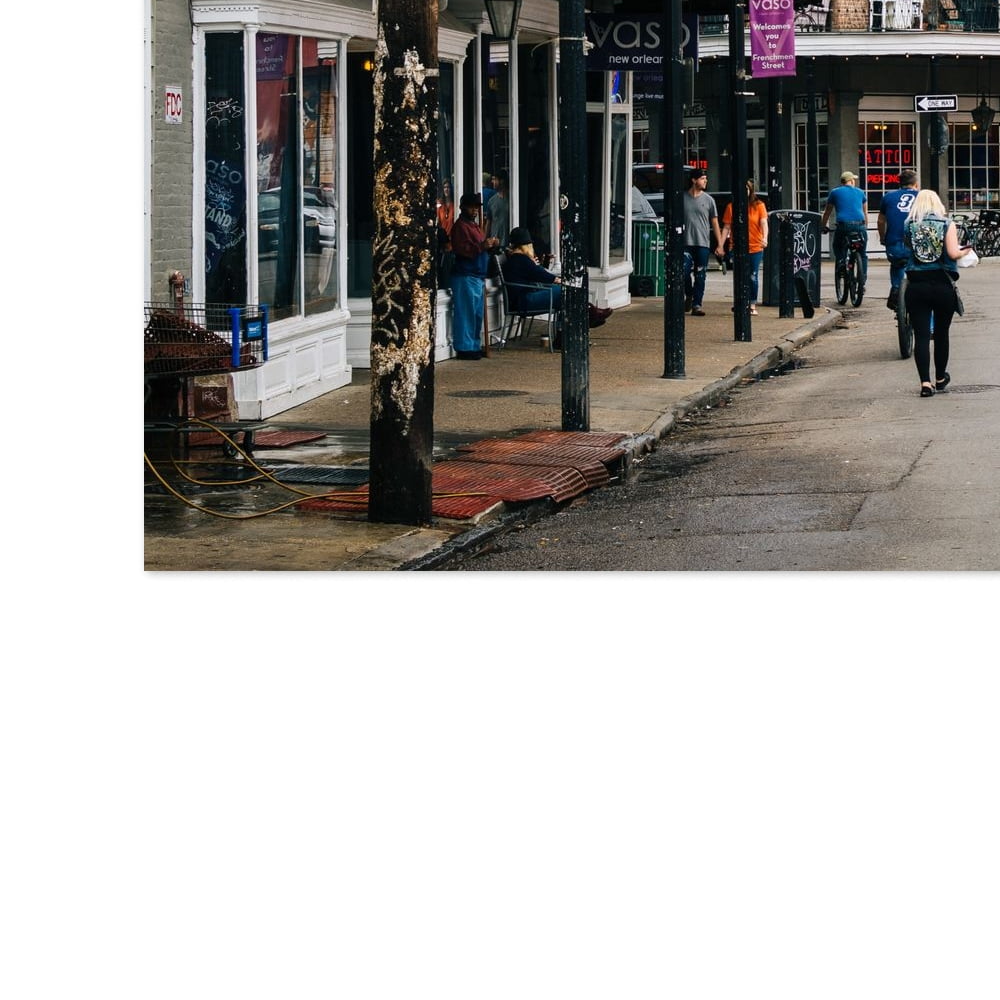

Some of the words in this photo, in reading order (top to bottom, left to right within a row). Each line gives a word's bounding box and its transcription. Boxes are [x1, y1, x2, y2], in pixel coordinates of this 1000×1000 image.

[753, 23, 791, 31] Welcomes
[609, 55, 630, 63] new
[753, 53, 794, 61] Frenchmen
[761, 61, 785, 69] Street
[166, 92, 182, 115] FDC
